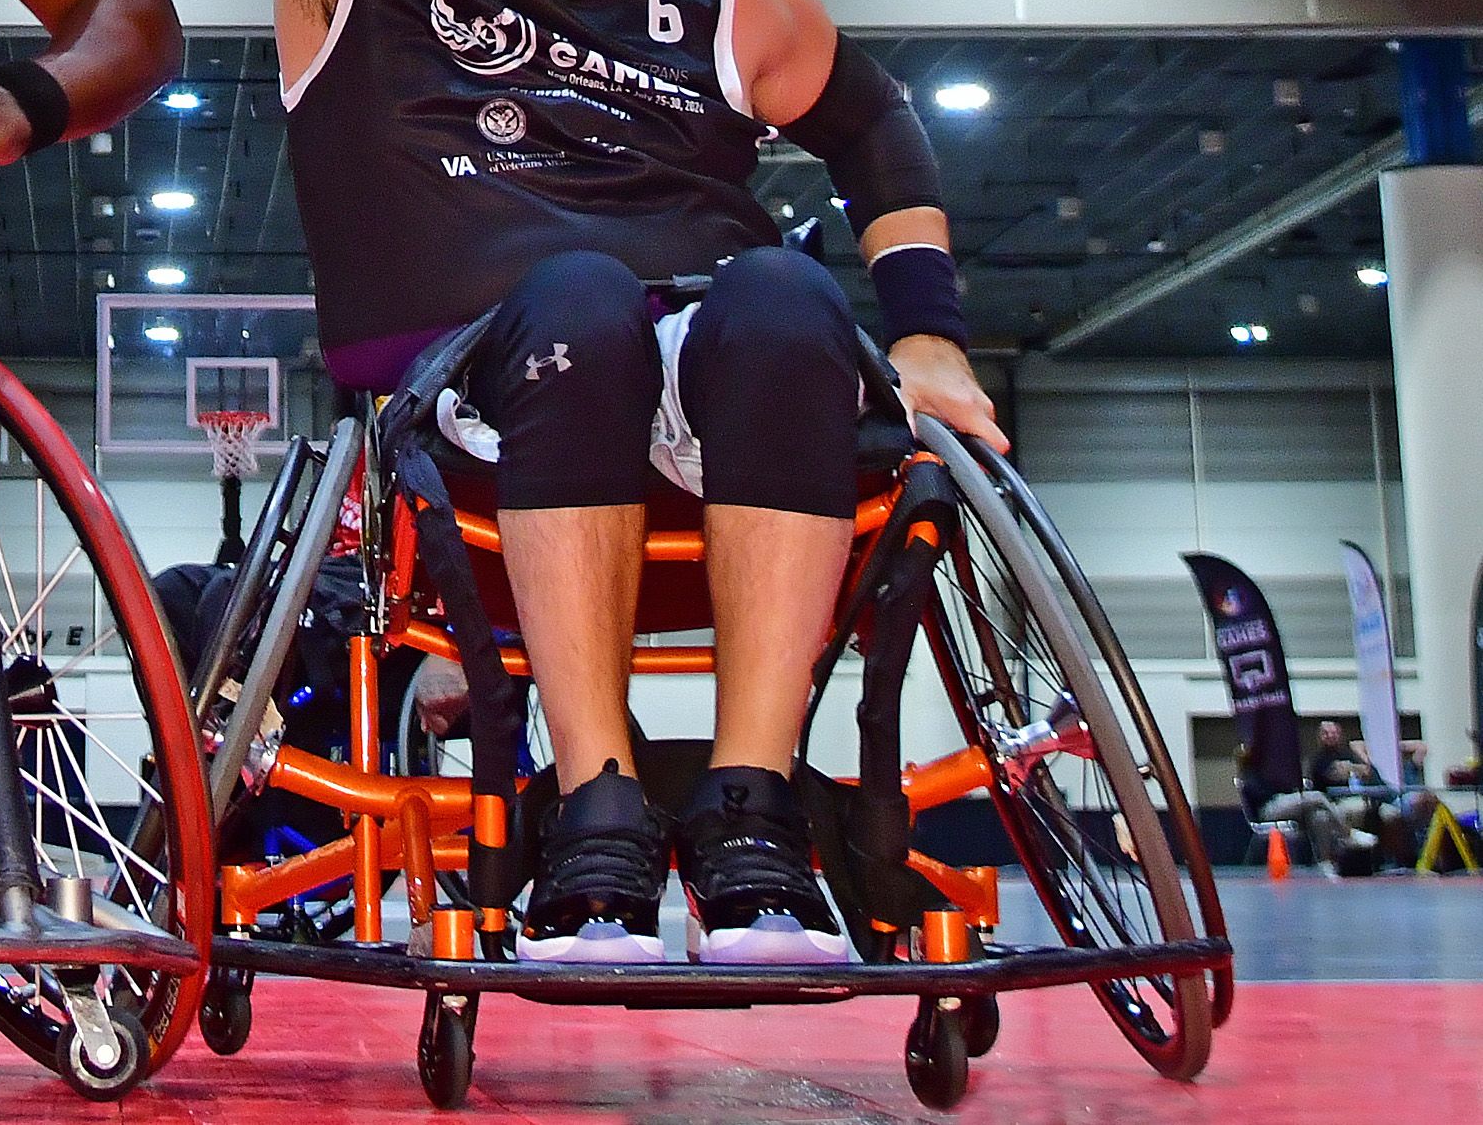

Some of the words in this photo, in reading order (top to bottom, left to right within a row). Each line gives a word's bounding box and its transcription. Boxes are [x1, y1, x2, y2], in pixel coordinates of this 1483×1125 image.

[568, 73, 609, 93] Orleans,
[655, 94, 684, 112] 25-30,
[684, 99, 705, 115] 2024
[441, 155, 477, 177] VA
